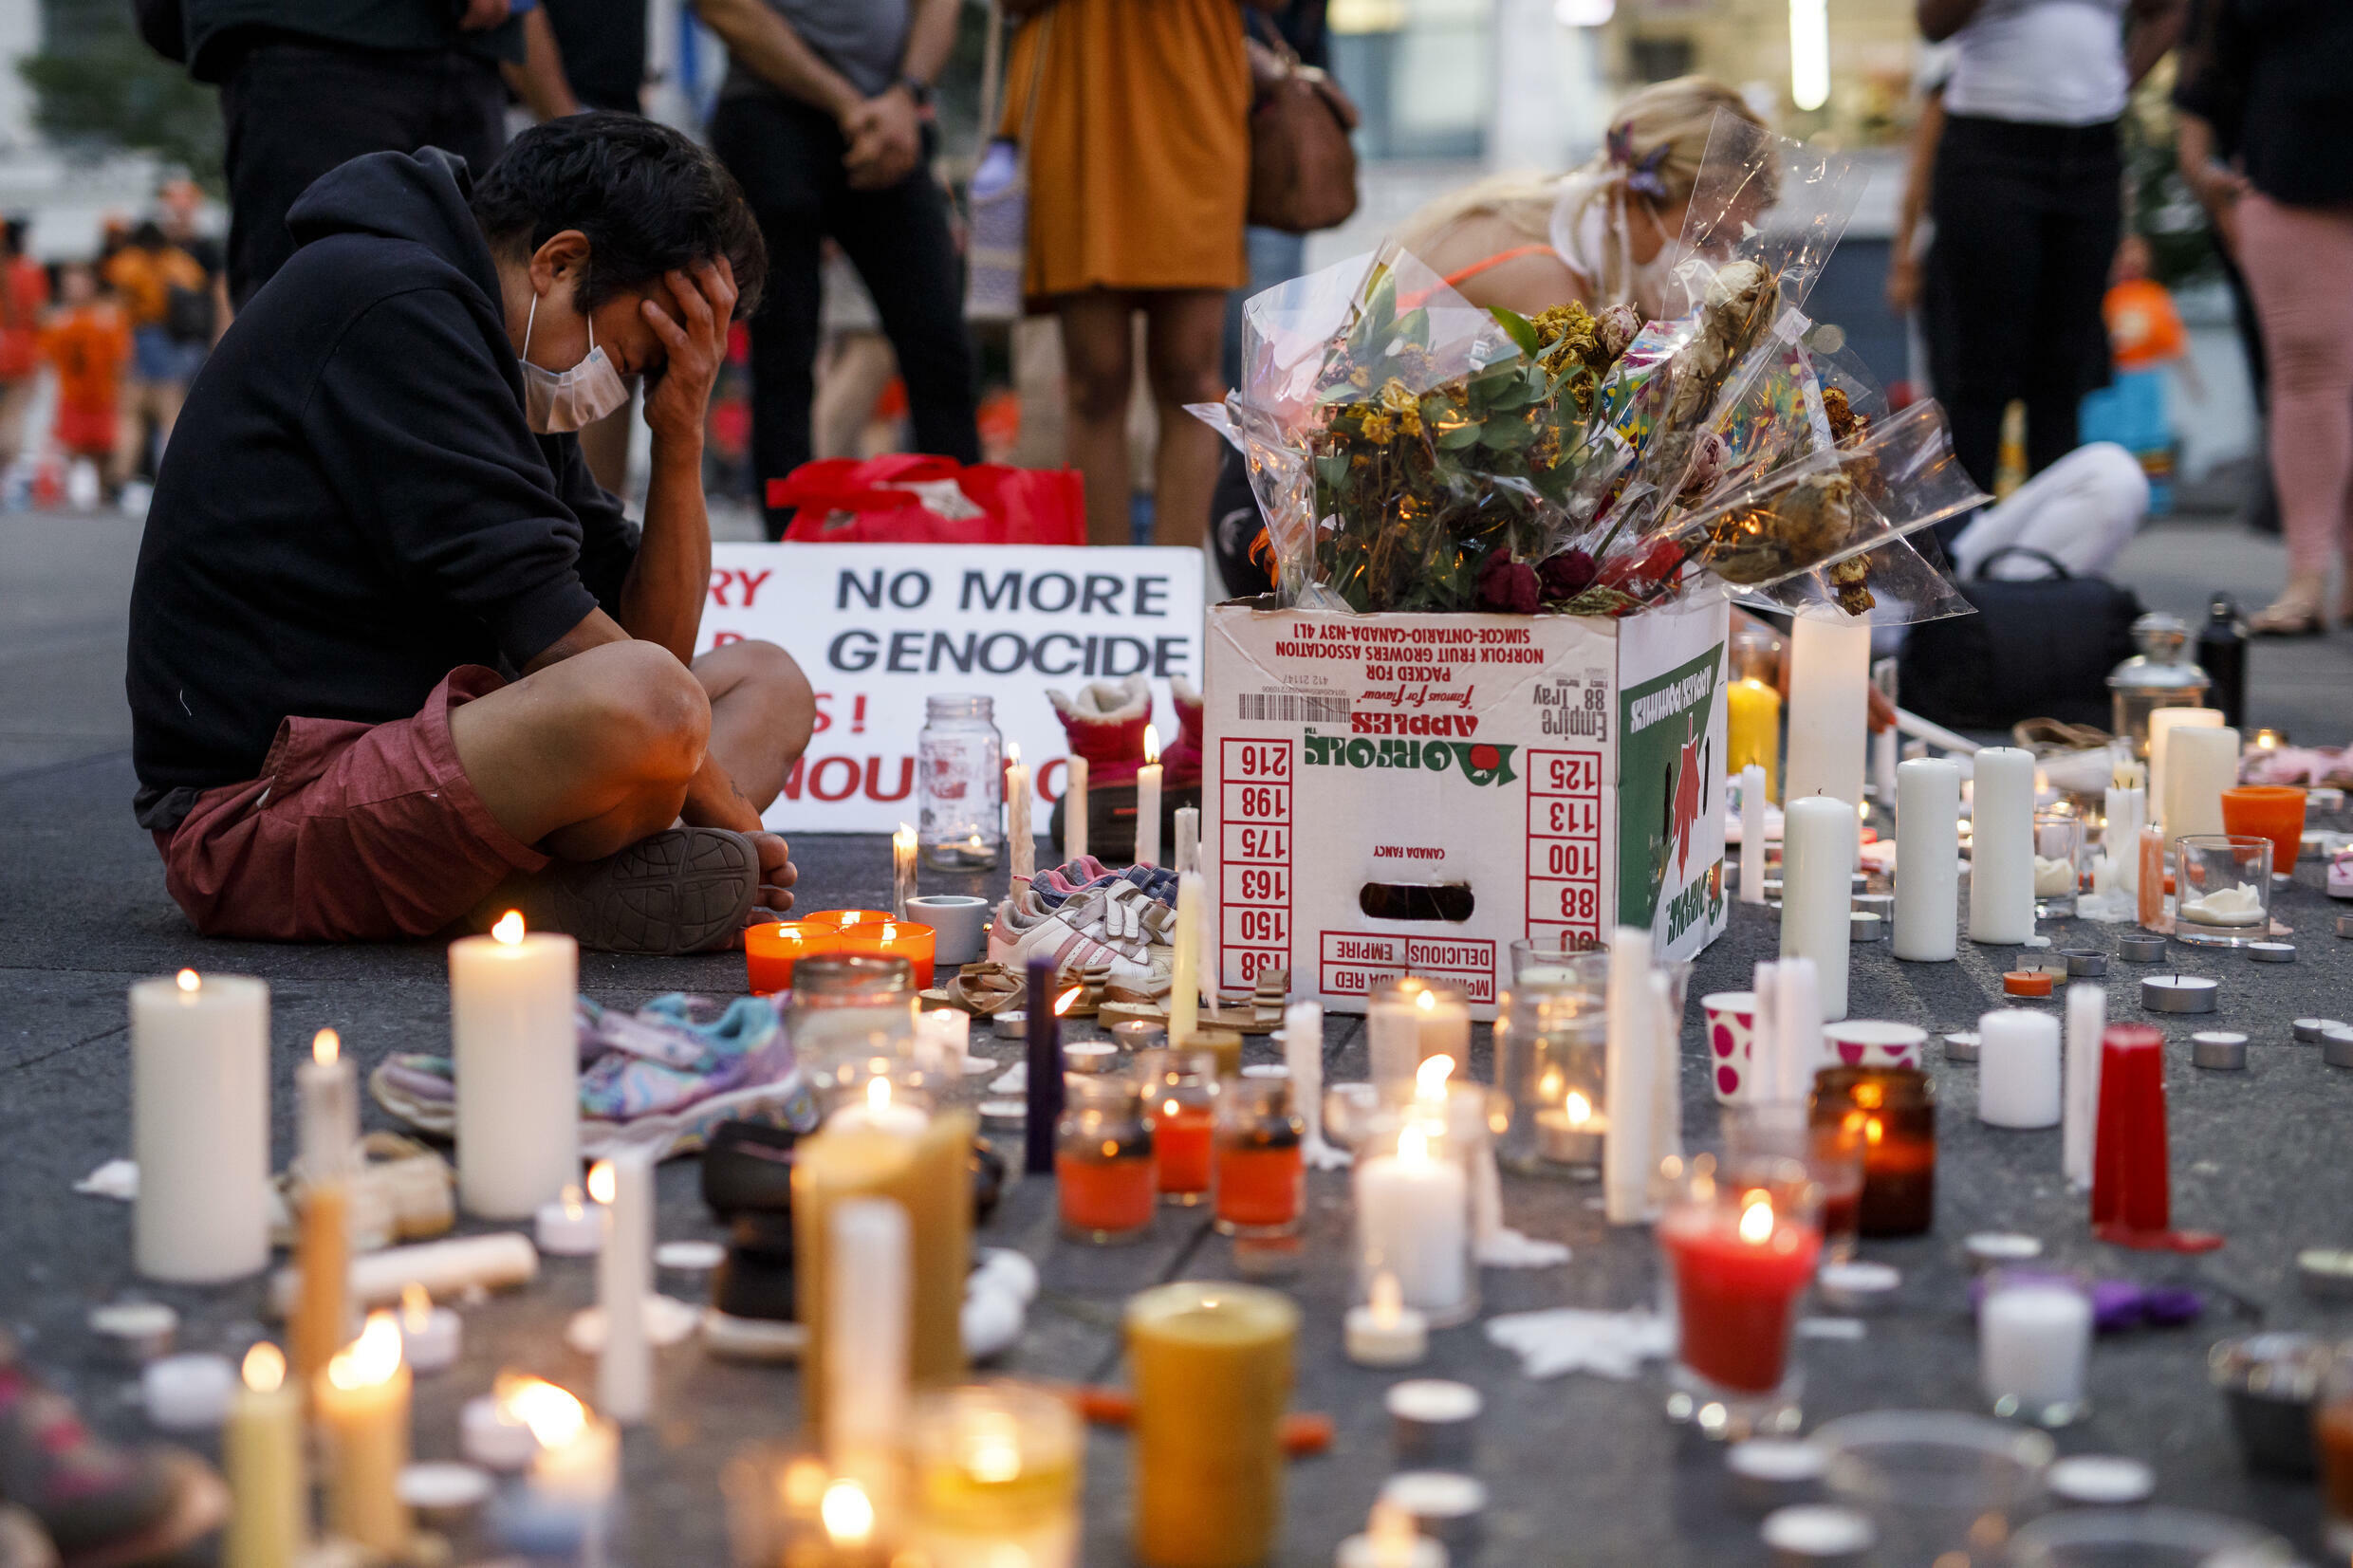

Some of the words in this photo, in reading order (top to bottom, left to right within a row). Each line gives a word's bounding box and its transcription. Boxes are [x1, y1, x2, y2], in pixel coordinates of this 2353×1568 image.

[836, 568, 932, 609] NO
[960, 571, 1171, 617] MORE
[1294, 623, 1316, 641] 4L1
[828, 631, 1190, 677] GENOCIDE
[1276, 641, 1361, 660] ASSOCIATION
[1364, 646, 1434, 662] GROWERS
[1436, 647, 1476, 664] FRUIT
[1480, 647, 1545, 665] NORFOLK
[1283, 674, 1310, 685] 21147
[1312, 675, 1329, 686] 412
[1365, 664, 1394, 681] FOR
[1398, 666, 1451, 682] PACKED
[1405, 684, 1428, 709] for
[1533, 683, 1569, 710] Tray
[1584, 690, 1604, 710] 88
[1350, 712, 1479, 738] APPLES
[1543, 705, 1608, 742] Empire
[1242, 746, 1287, 776] 216
[1304, 734, 1518, 787] NORFOLK
[1550, 759, 1596, 791] 125
[1242, 787, 1286, 819] 198
[1550, 802, 1595, 834] 113
[1242, 829, 1286, 859] 175
[1373, 845, 1404, 858] FANCY
[1406, 847, 1445, 860] CANADA
[1547, 844, 1595, 876] 100
[1242, 870, 1287, 900] 163
[1561, 888, 1595, 918] 88
[1241, 912, 1287, 940] 150
[1336, 940, 1393, 960] EMPIRE
[1410, 945, 1490, 967] DELICIOUS
[1242, 951, 1282, 981] 138
[1335, 970, 1365, 990] RED
